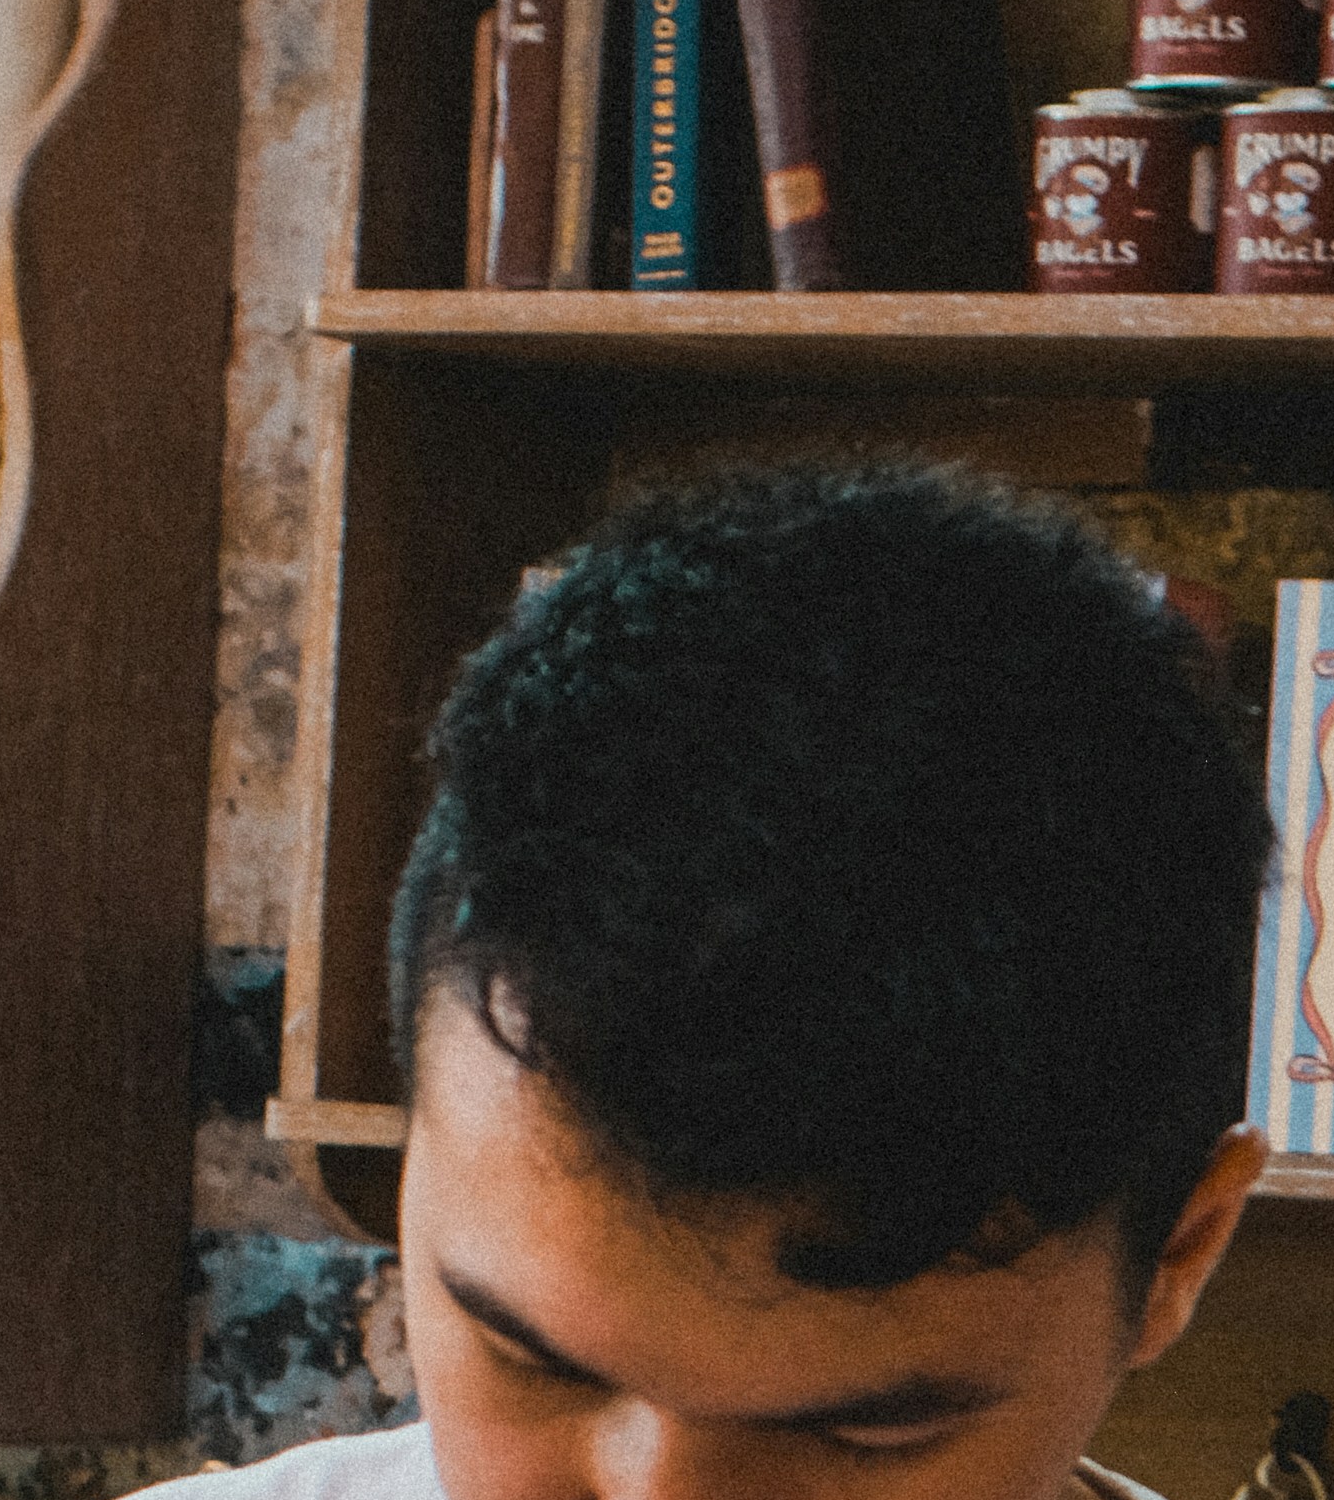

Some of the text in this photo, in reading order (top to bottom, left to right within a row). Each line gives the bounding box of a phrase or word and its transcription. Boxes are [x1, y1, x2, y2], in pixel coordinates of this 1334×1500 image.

[1140, 15, 1247, 43] BAGELS
[1034, 134, 1148, 190] GRUMPY
[1035, 238, 1139, 267] BAGELS
